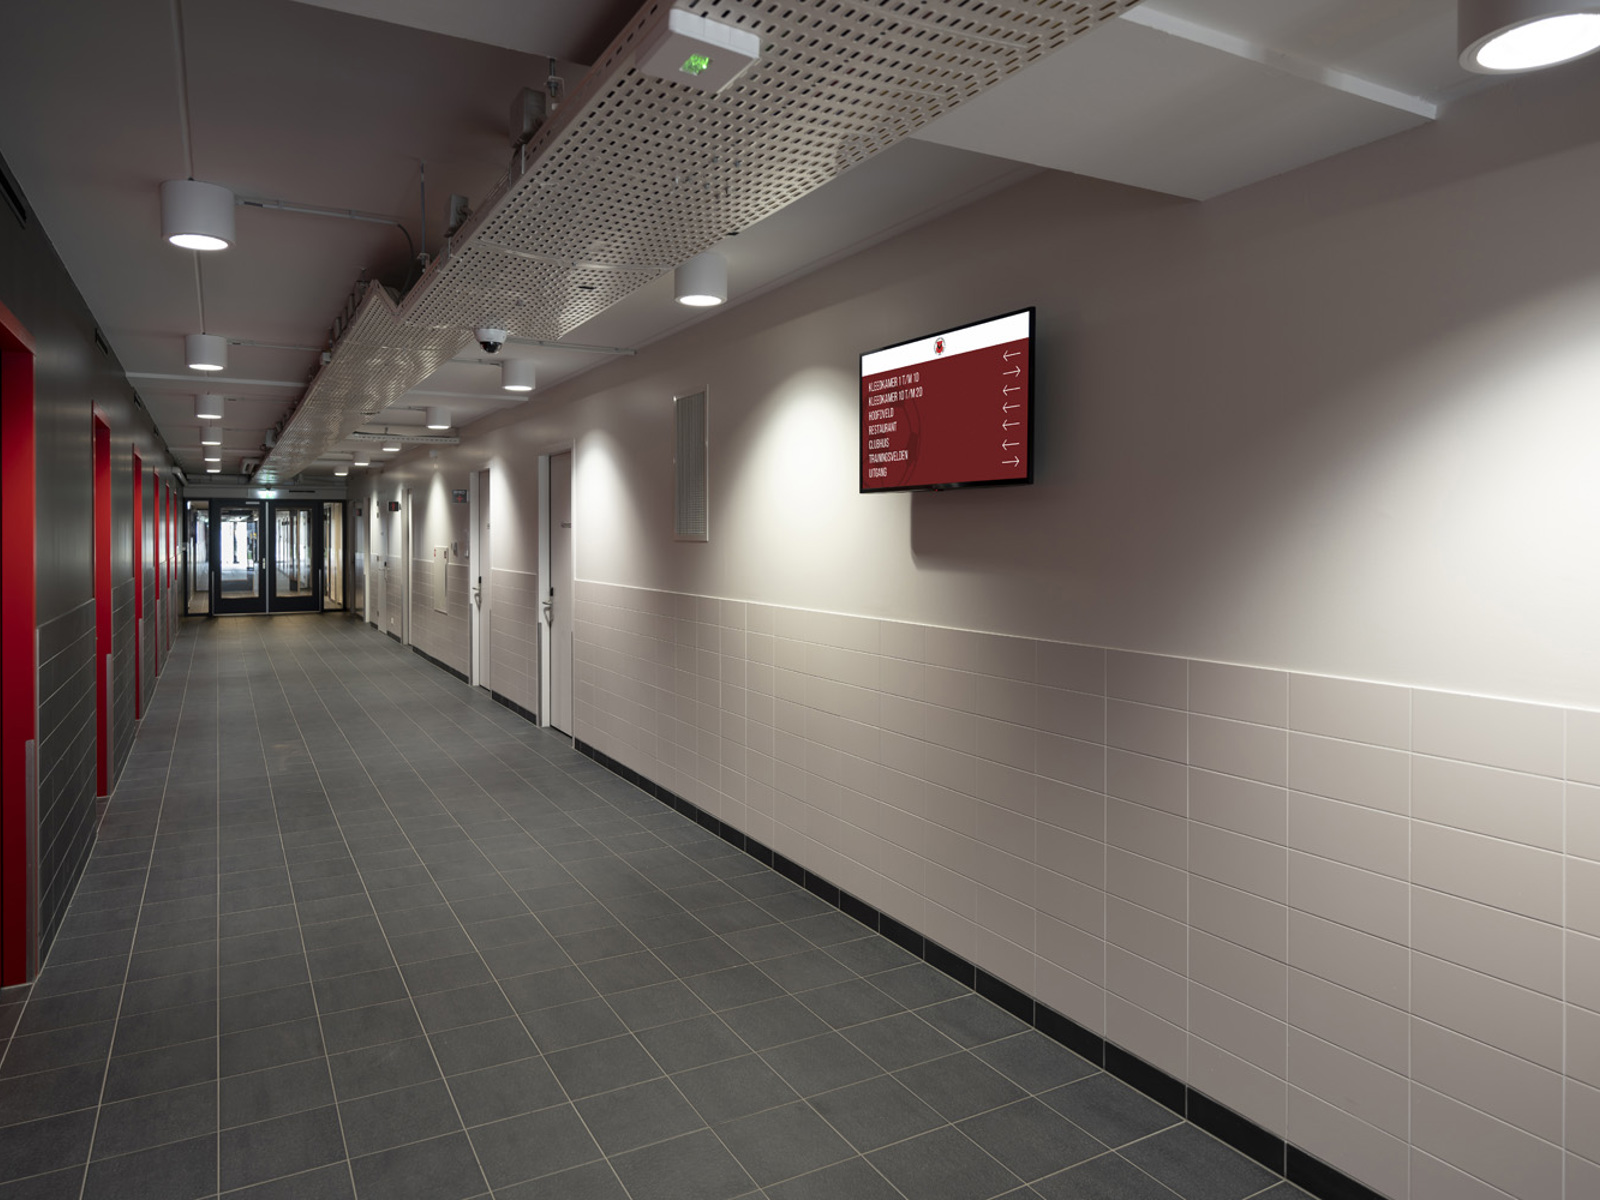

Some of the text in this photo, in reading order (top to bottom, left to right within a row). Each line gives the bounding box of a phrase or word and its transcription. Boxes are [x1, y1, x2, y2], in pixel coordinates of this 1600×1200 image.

[913, 371, 920, 383] 10
[899, 389, 905, 401] 10
[916, 386, 923, 398] 20
[869, 421, 897, 435] RESTAURANT
[869, 437, 890, 450] CLUBHUIS
